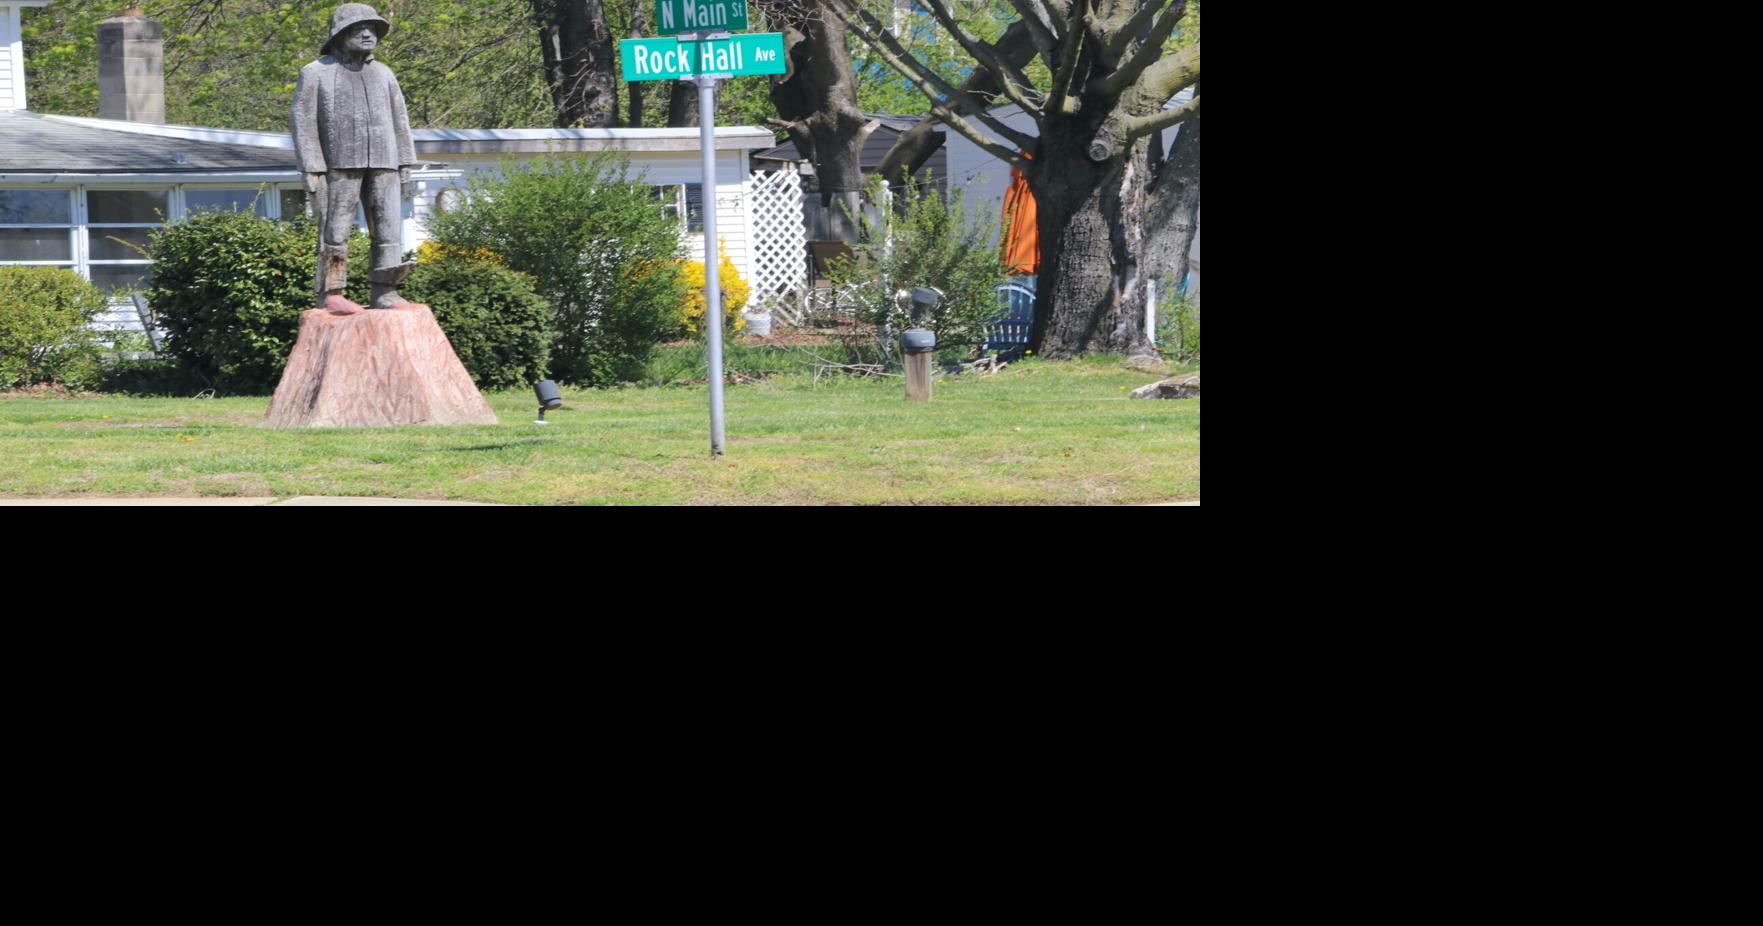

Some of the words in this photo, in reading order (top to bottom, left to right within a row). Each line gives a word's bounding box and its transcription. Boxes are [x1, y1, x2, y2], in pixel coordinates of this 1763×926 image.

[662, 1, 674, 29] N
[683, 0, 727, 28] Main
[732, 2, 743, 17] St
[634, 44, 691, 75] Rock
[701, 41, 743, 71] Hall
[755, 47, 776, 62] Ave
